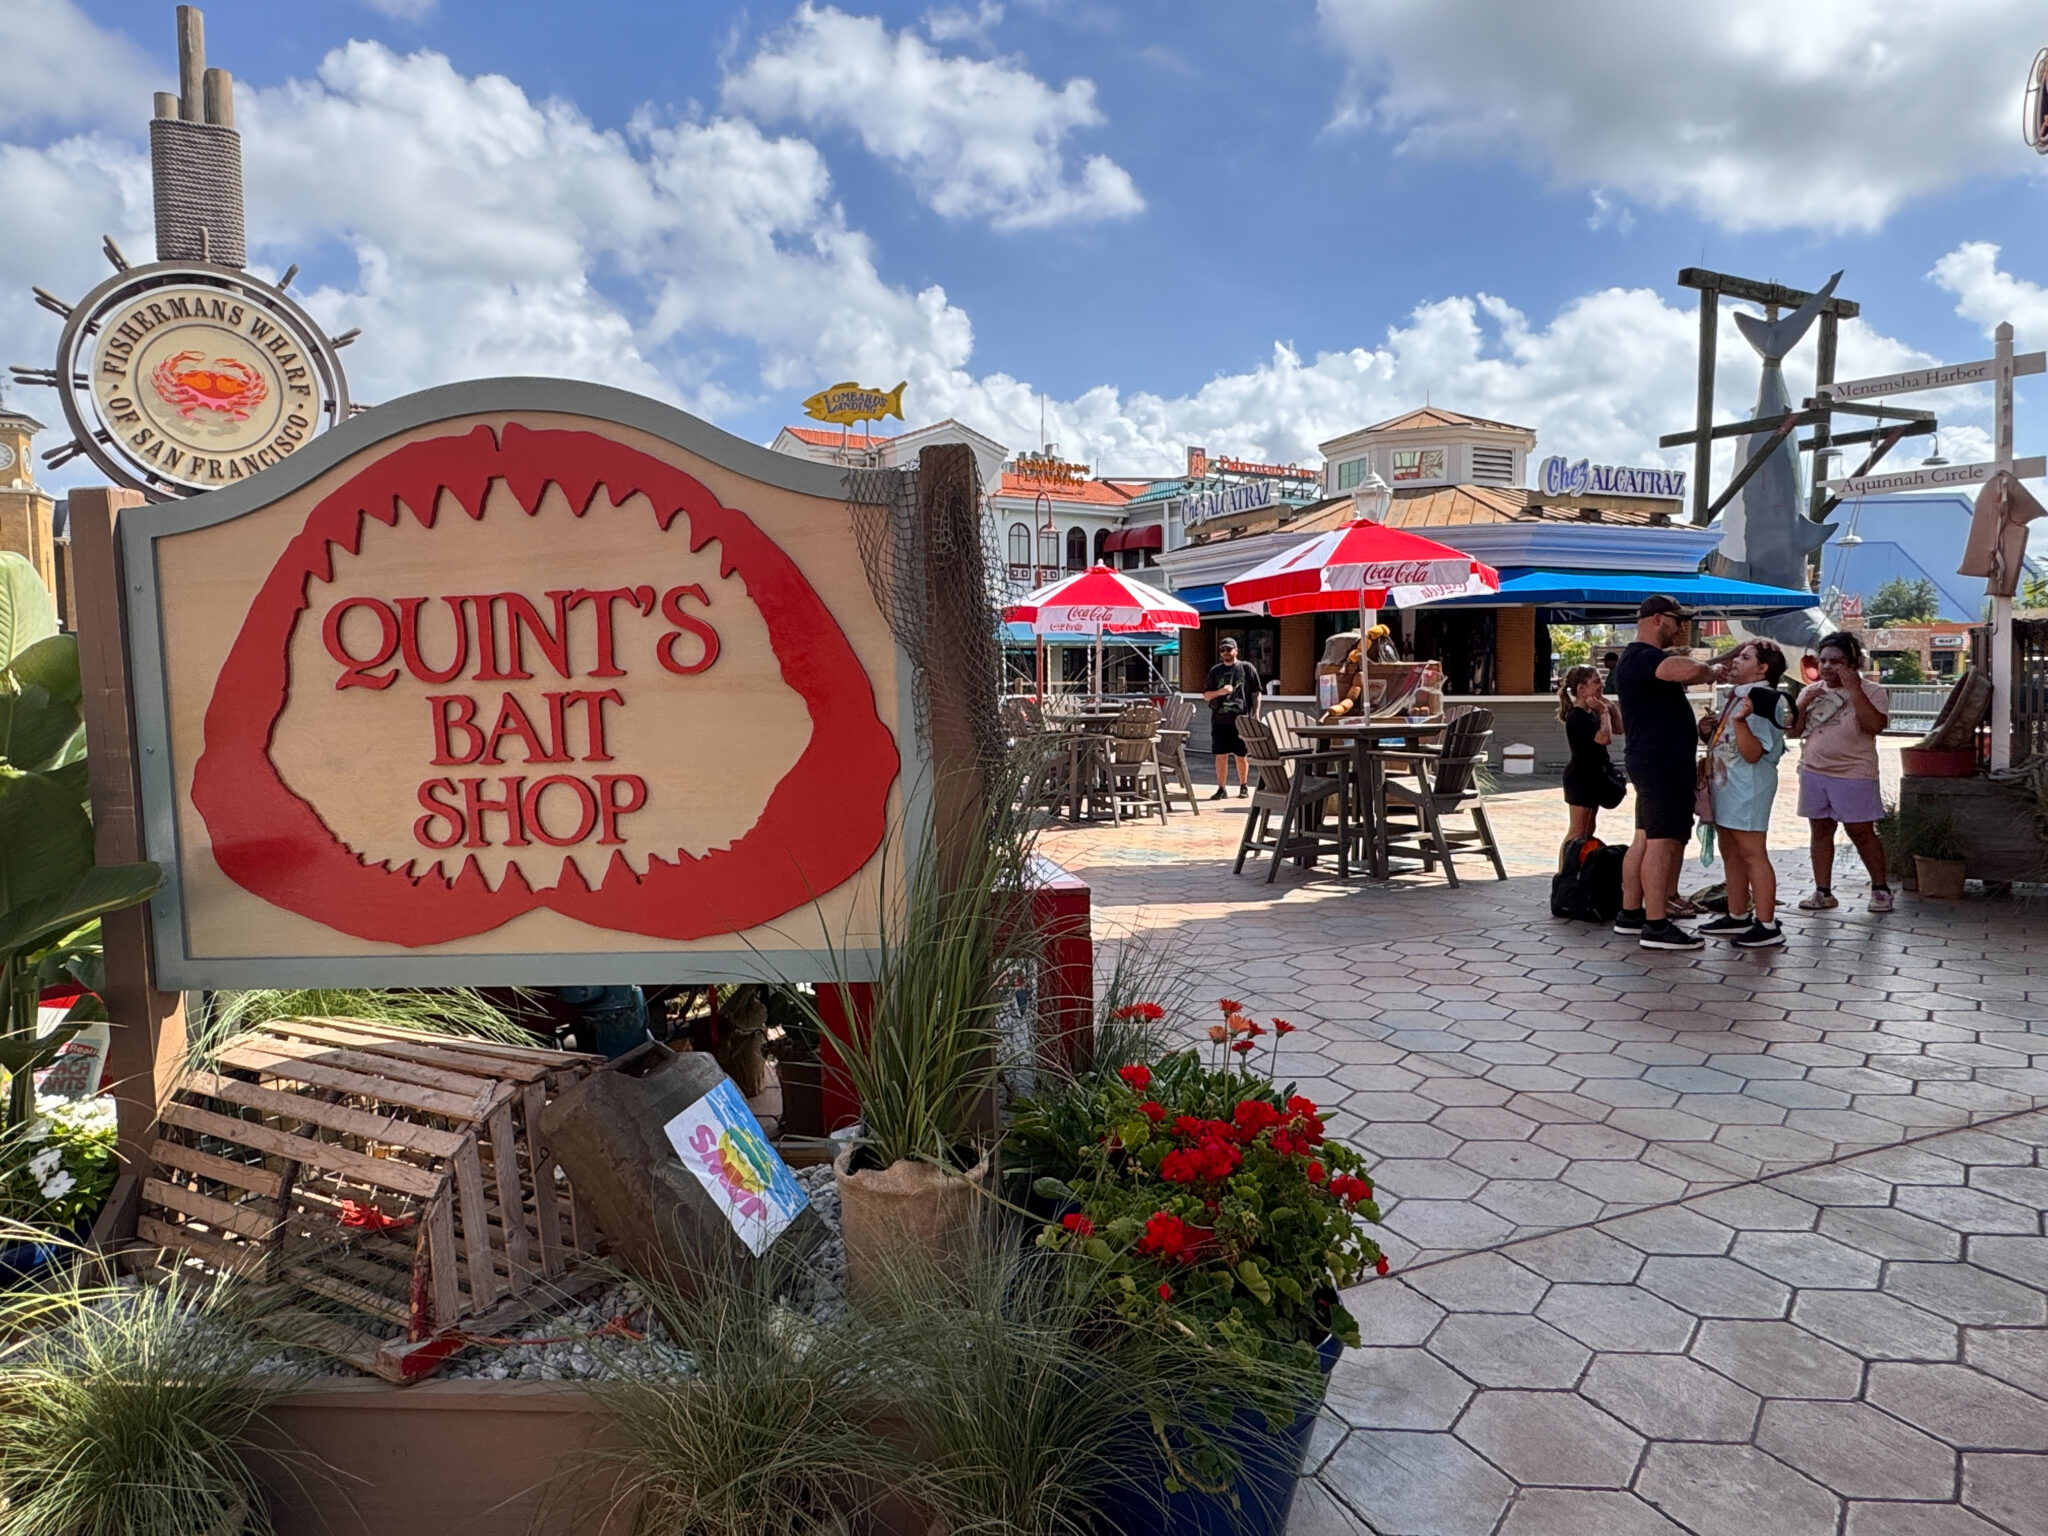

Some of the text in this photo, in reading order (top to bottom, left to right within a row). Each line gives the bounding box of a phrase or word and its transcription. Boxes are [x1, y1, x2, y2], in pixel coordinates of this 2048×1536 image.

[103, 297, 311, 397] FISHERMANS WHARF
[1836, 367, 1987, 399] Menemsha Harbor
[109, 397, 309, 480] OF SAN FRANCISCO
[1181, 482, 1271, 527] Chez ALCATRAZ
[1547, 458, 1685, 496] Chez ALCATRAZ
[1840, 465, 1984, 495] Aquinnah Circle
[1363, 561, 1432, 585] Coca-Cola
[322, 584, 720, 690] QUINT'S
[1067, 606, 1114, 622] Coca-Cola
[425, 689, 625, 766] BAIT
[413, 774, 647, 849] SHOP
[689, 1124, 768, 1221] JAWS
